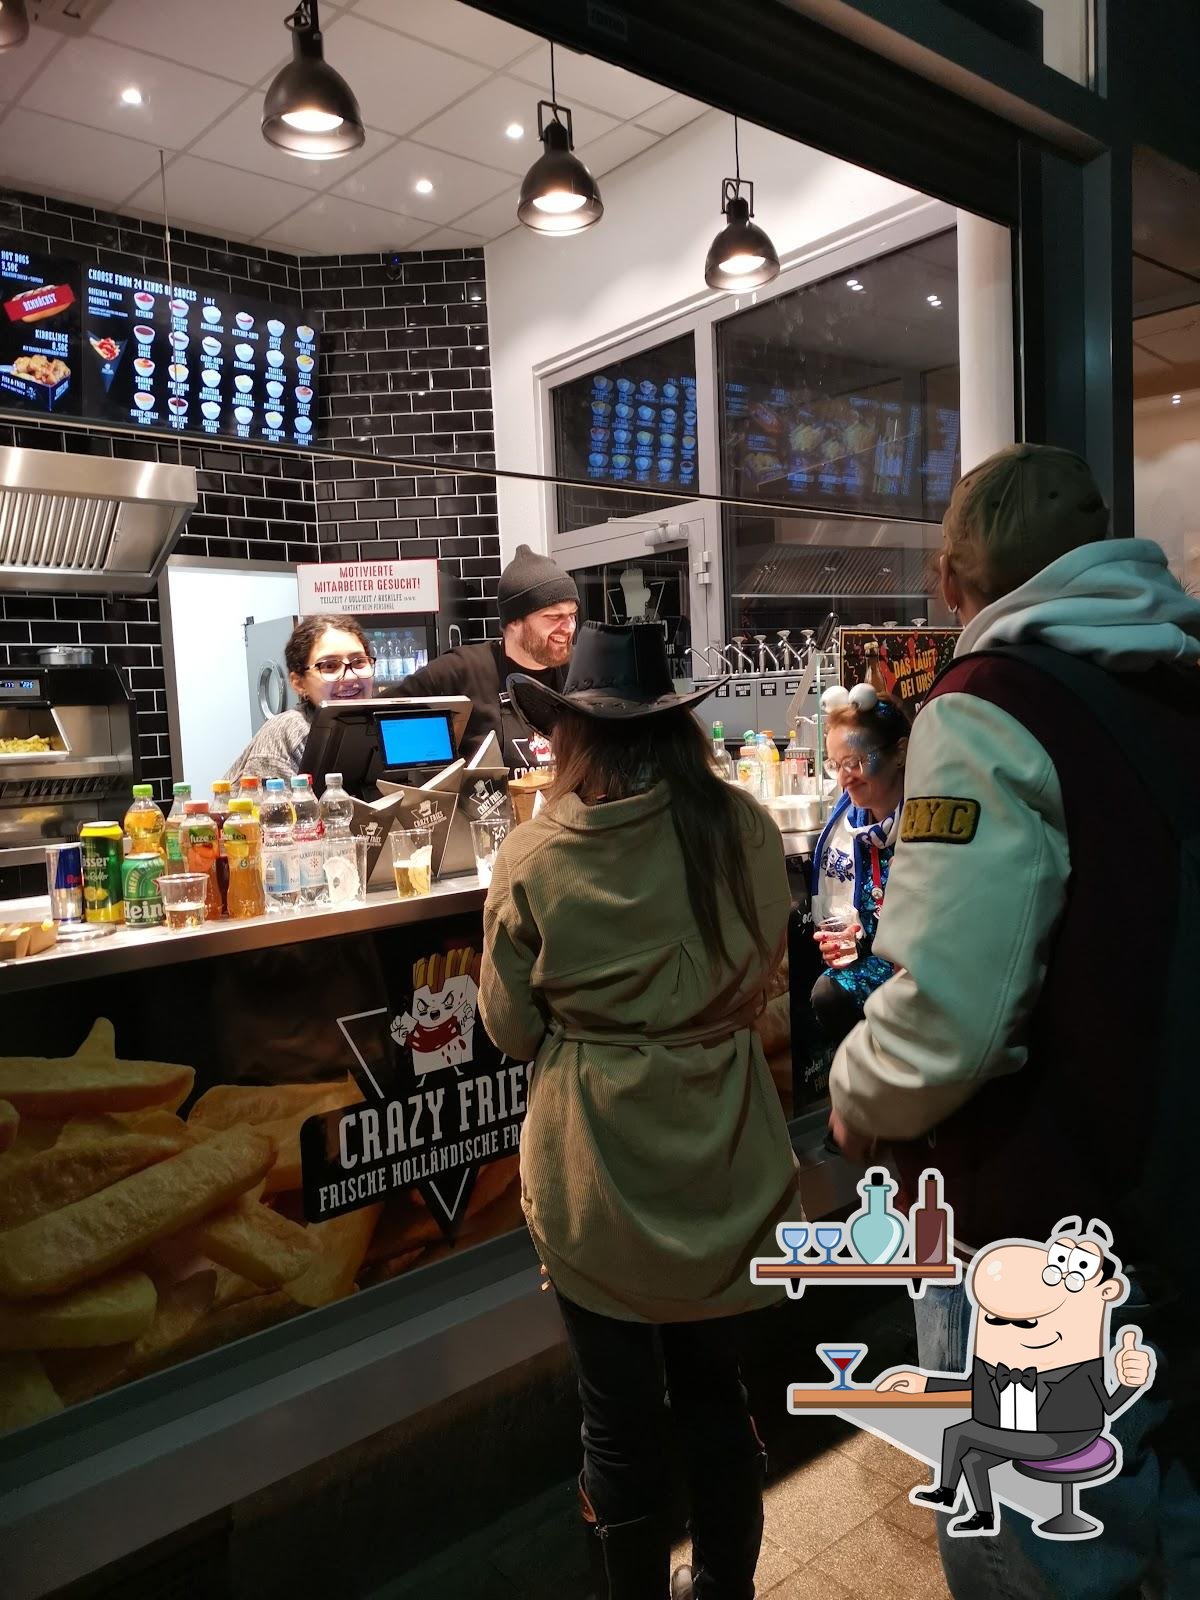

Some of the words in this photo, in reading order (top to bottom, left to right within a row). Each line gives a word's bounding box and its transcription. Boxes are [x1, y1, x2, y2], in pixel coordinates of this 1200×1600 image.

[88, 268, 113, 284] CHOOSE
[115, 273, 132, 288] FROM
[133, 279, 142, 290] 24
[143, 280, 163, 294] KINDS
[173, 286, 197, 301] SAUCES
[339, 565, 394, 578] MOTIVIERTE
[314, 579, 374, 593] MITARBEITER
[377, 577, 421, 591] GESUCHT!
[320, 596, 342, 604] TEILZEIT
[349, 594, 372, 603] VOLLZEIT
[893, 657, 911, 679] DAS
[913, 648, 936, 672] LÄUFT
[901, 678, 915, 699] BEI
[413, 818, 429, 828] CRAZY
[338, 1087, 446, 1170] CRAZY
[319, 1166, 387, 1213] FRISCHE
[392, 1129, 499, 1187] HOLLÄNDISCHE
